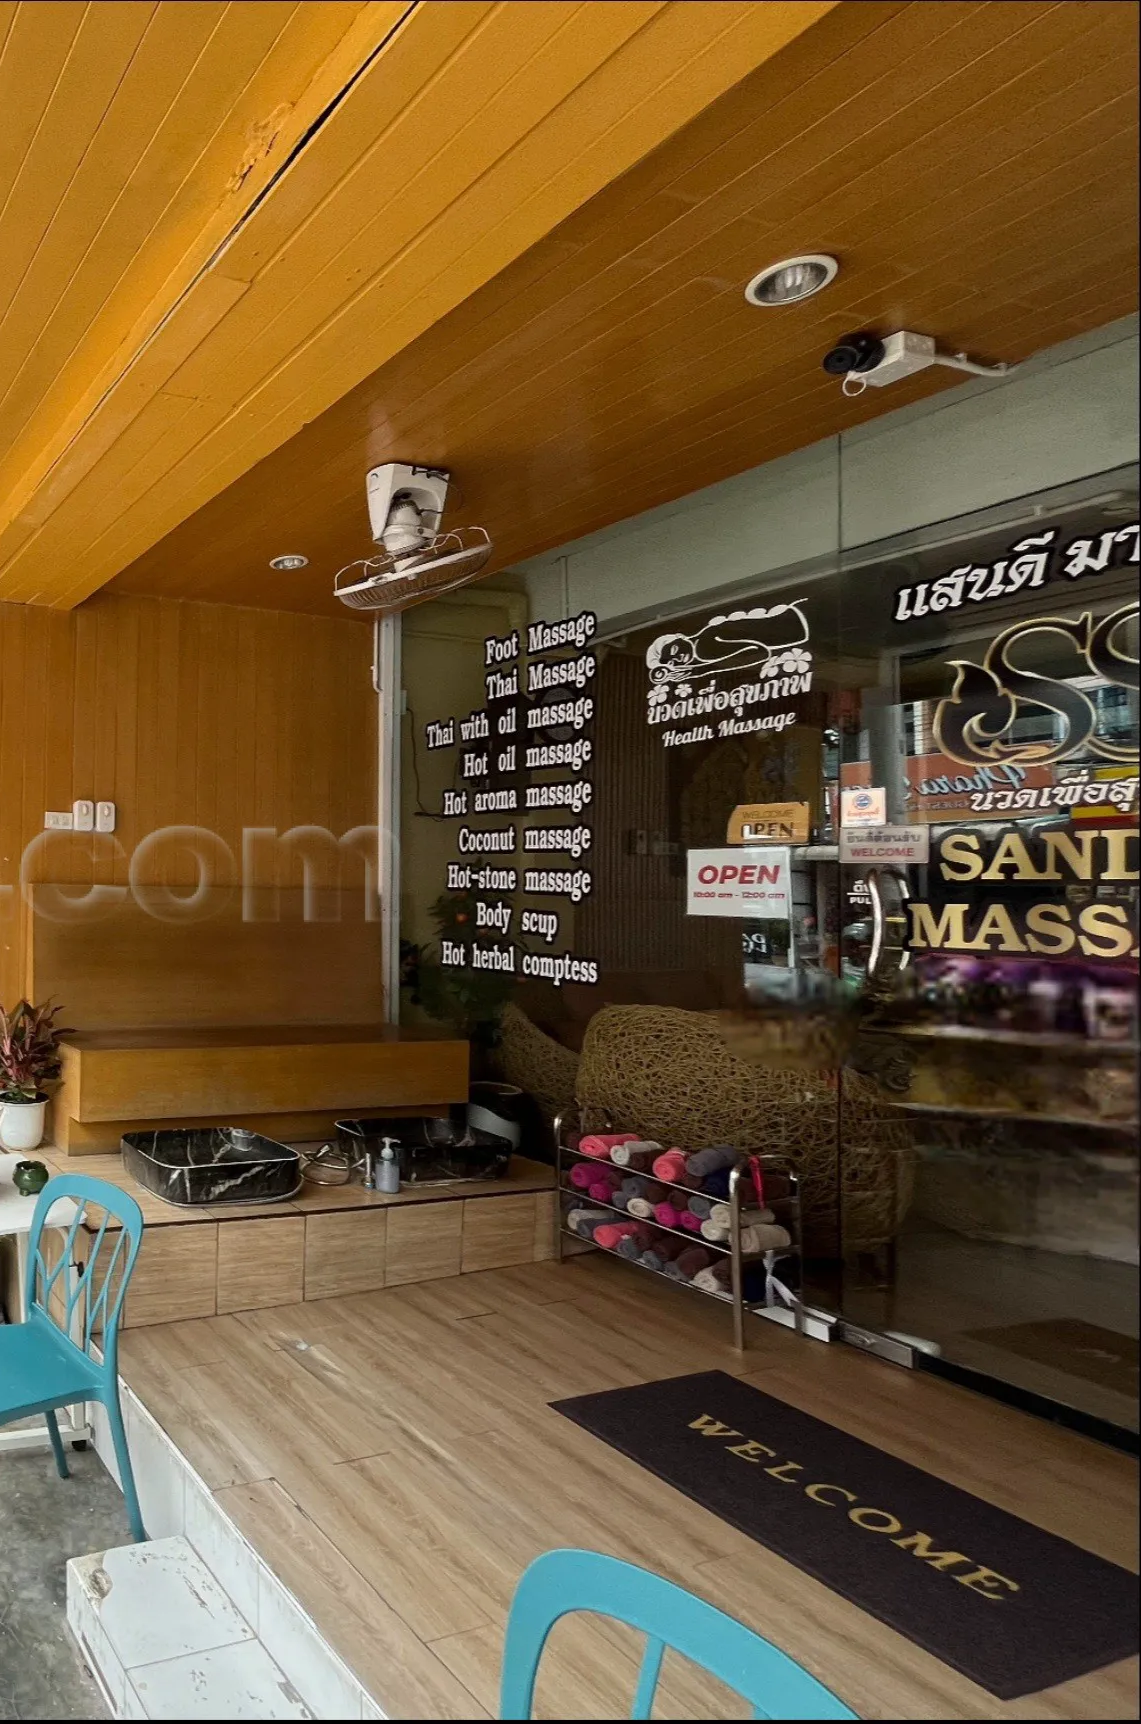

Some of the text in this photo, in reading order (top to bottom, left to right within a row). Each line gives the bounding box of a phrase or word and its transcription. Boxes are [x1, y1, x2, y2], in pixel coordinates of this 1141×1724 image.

[895, 531, 1055, 621] แสนดี
[485, 615, 595, 664] Foot Massage
[486, 656, 596, 700] Thai Massage
[647, 672, 813, 725] นวดเพื่อสุขภาพ
[427, 697, 593, 748] Thai with oil massage
[662, 712, 796, 747] Health Massage
[463, 739, 591, 777] Hot oil massage
[444, 781, 592, 815] Hot aroma massage
[742, 809, 794, 819] WELCOME
[459, 826, 591, 857] Coconut massage
[741, 822, 794, 838] OPEN
[850, 848, 915, 857] WELCOME
[447, 864, 591, 901] Hot-stone massage
[698, 865, 780, 885] OPEN
[476, 902, 558, 942] Body scup
[907, 904, 1140, 957] MASS
[442, 941, 598, 986] Hot herbal comptess
[687, 1413, 1021, 1600] WELCOME
